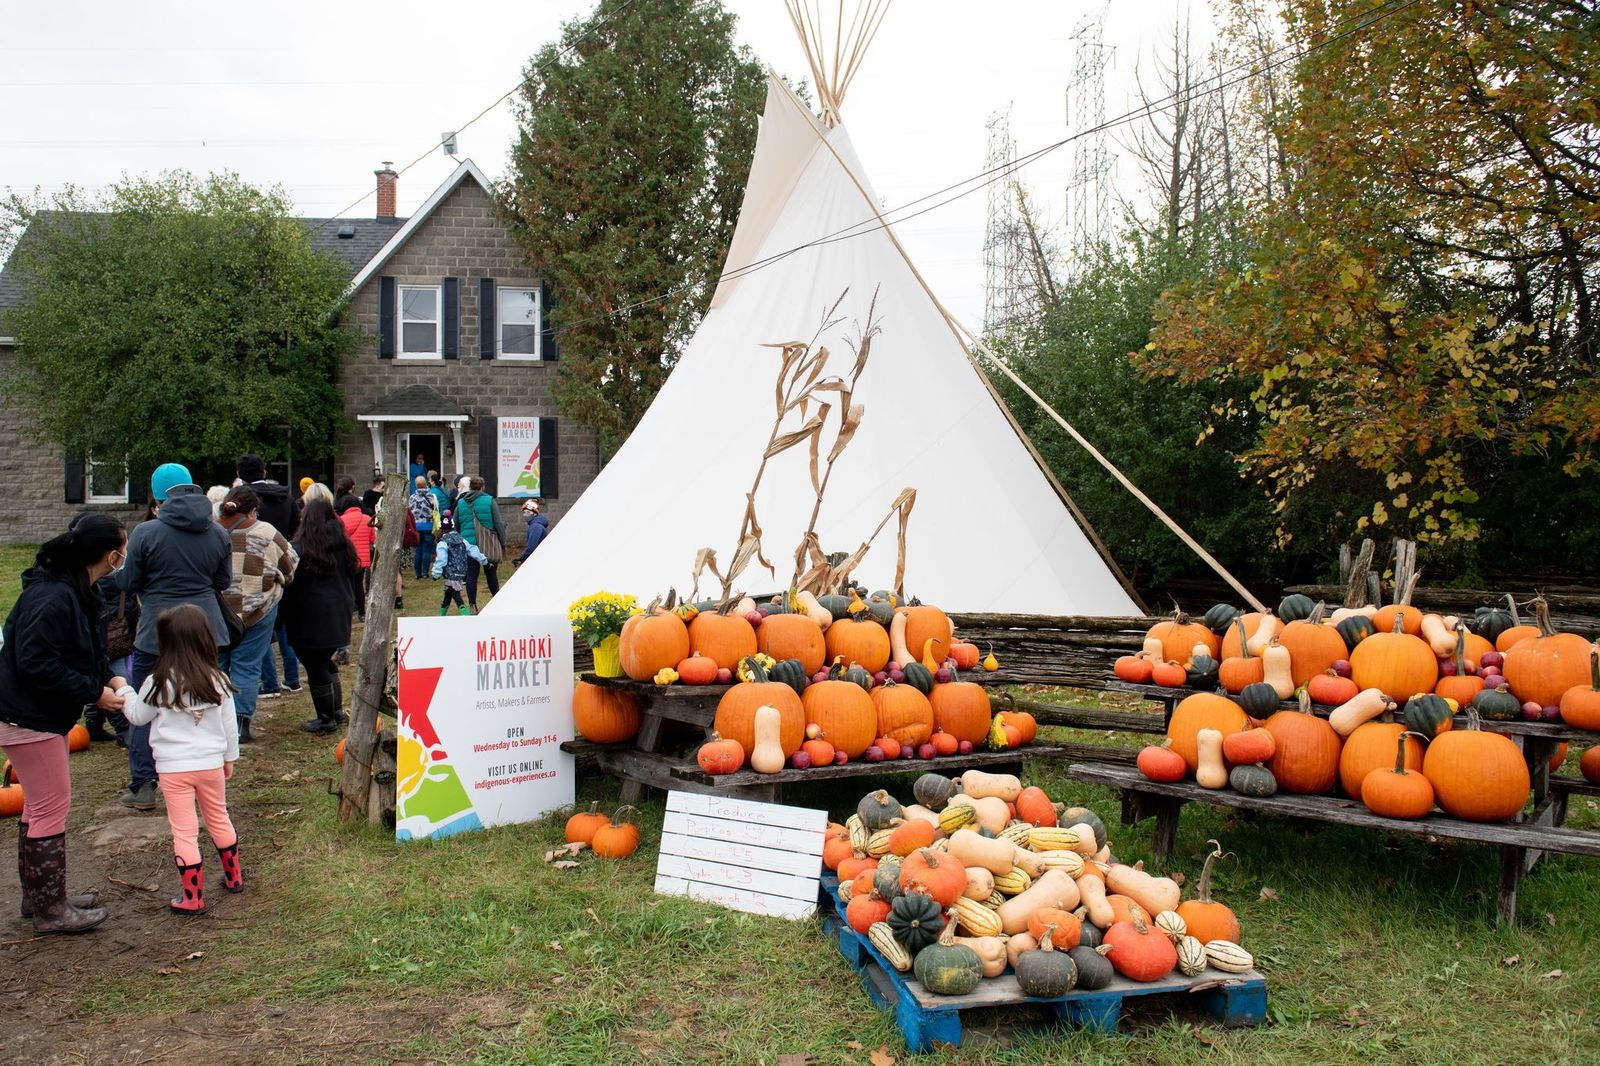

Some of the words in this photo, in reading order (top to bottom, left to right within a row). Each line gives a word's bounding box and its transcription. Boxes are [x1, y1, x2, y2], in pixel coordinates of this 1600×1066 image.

[502, 430, 534, 439] MARKET
[477, 634, 551, 662] MĀDAHÒKÌ
[477, 660, 551, 691] MARKET
[476, 699, 496, 710] Artists,
[498, 697, 520, 708] Makers
[521, 696, 526, 705] &
[526, 695, 551, 705] Farmers
[507, 727, 524, 738] OPEN
[474, 741, 510, 752] Wednesday
[512, 740, 518, 748] to
[520, 736, 542, 747] Sunday
[544, 734, 557, 743] 11-6
[488, 765, 506, 777] VISIT
[509, 764, 517, 774] US
[520, 760, 543, 772] ONLINE
[475, 770, 557, 789] indigenous-experiences.ca
[708, 796, 766, 818] Produce
